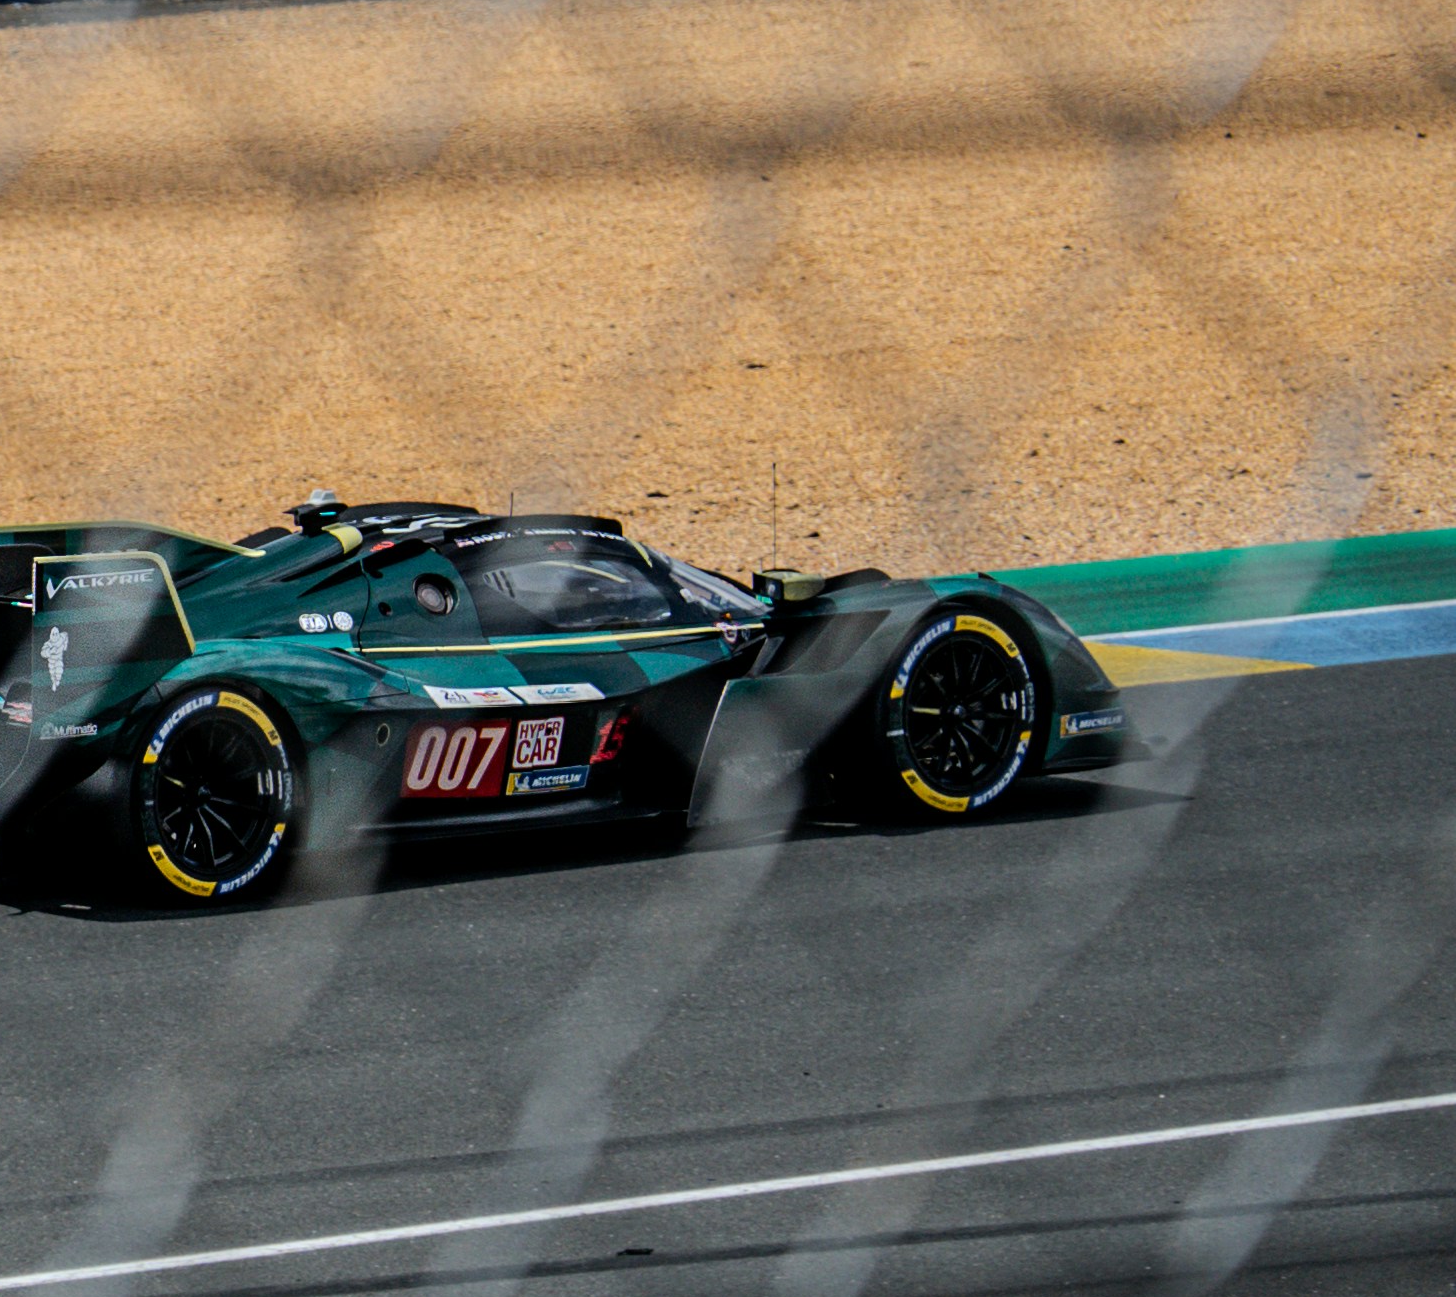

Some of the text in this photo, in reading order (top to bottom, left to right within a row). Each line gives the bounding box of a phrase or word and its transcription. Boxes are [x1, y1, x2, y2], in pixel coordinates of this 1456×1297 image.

[46, 568, 155, 600] VALKYRIE
[903, 620, 951, 673] MICHELIN
[159, 693, 214, 739] MICHELIN
[519, 720, 562, 739] HYPER
[1079, 715, 1123, 729] MICHELIN
[406, 726, 508, 791] 007
[516, 736, 558, 764] CAR
[532, 773, 582, 788] MICHELIN
[220, 846, 273, 893] MICHELIN
